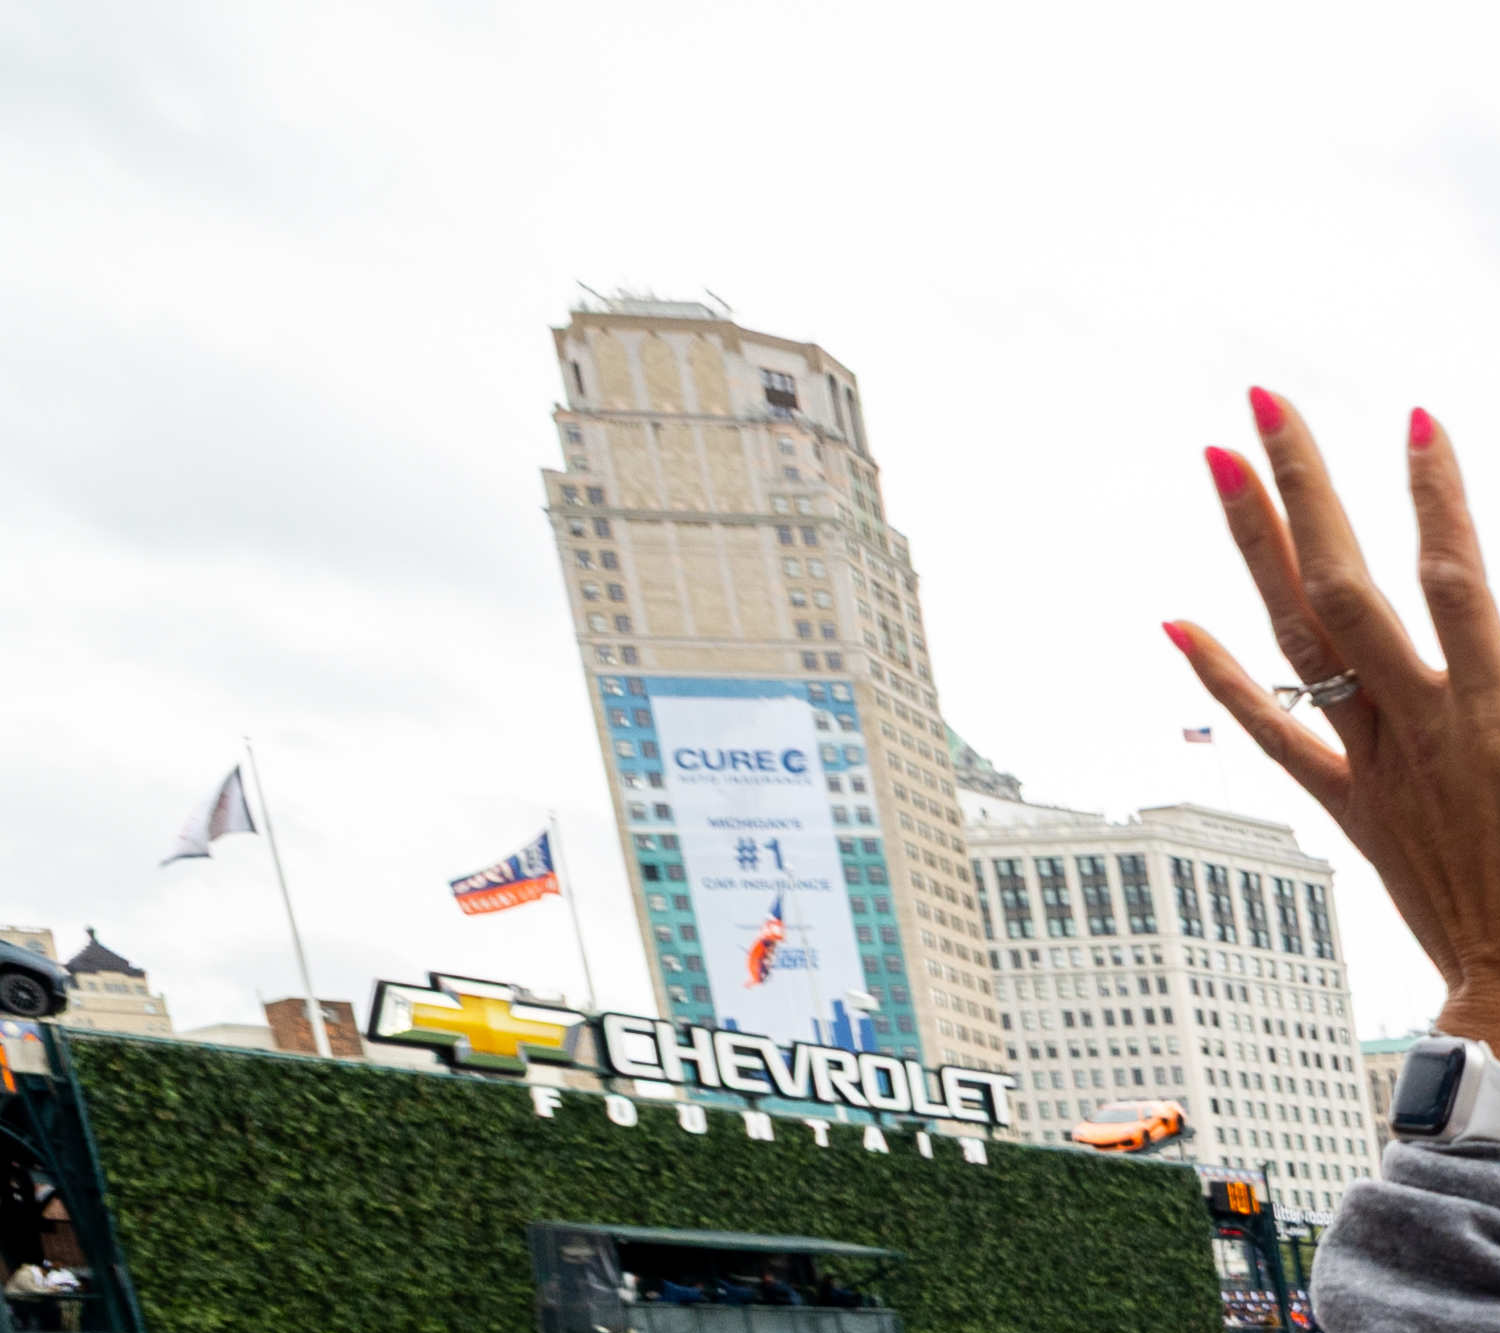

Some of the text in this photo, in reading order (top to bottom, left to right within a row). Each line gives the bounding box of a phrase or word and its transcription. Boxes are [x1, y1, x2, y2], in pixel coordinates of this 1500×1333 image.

[674, 749, 776, 772] CURE
[734, 837, 783, 872] #1
[604, 1013, 1015, 1124] CHEVROLET
[530, 1086, 987, 1165] FOUNTAIN
